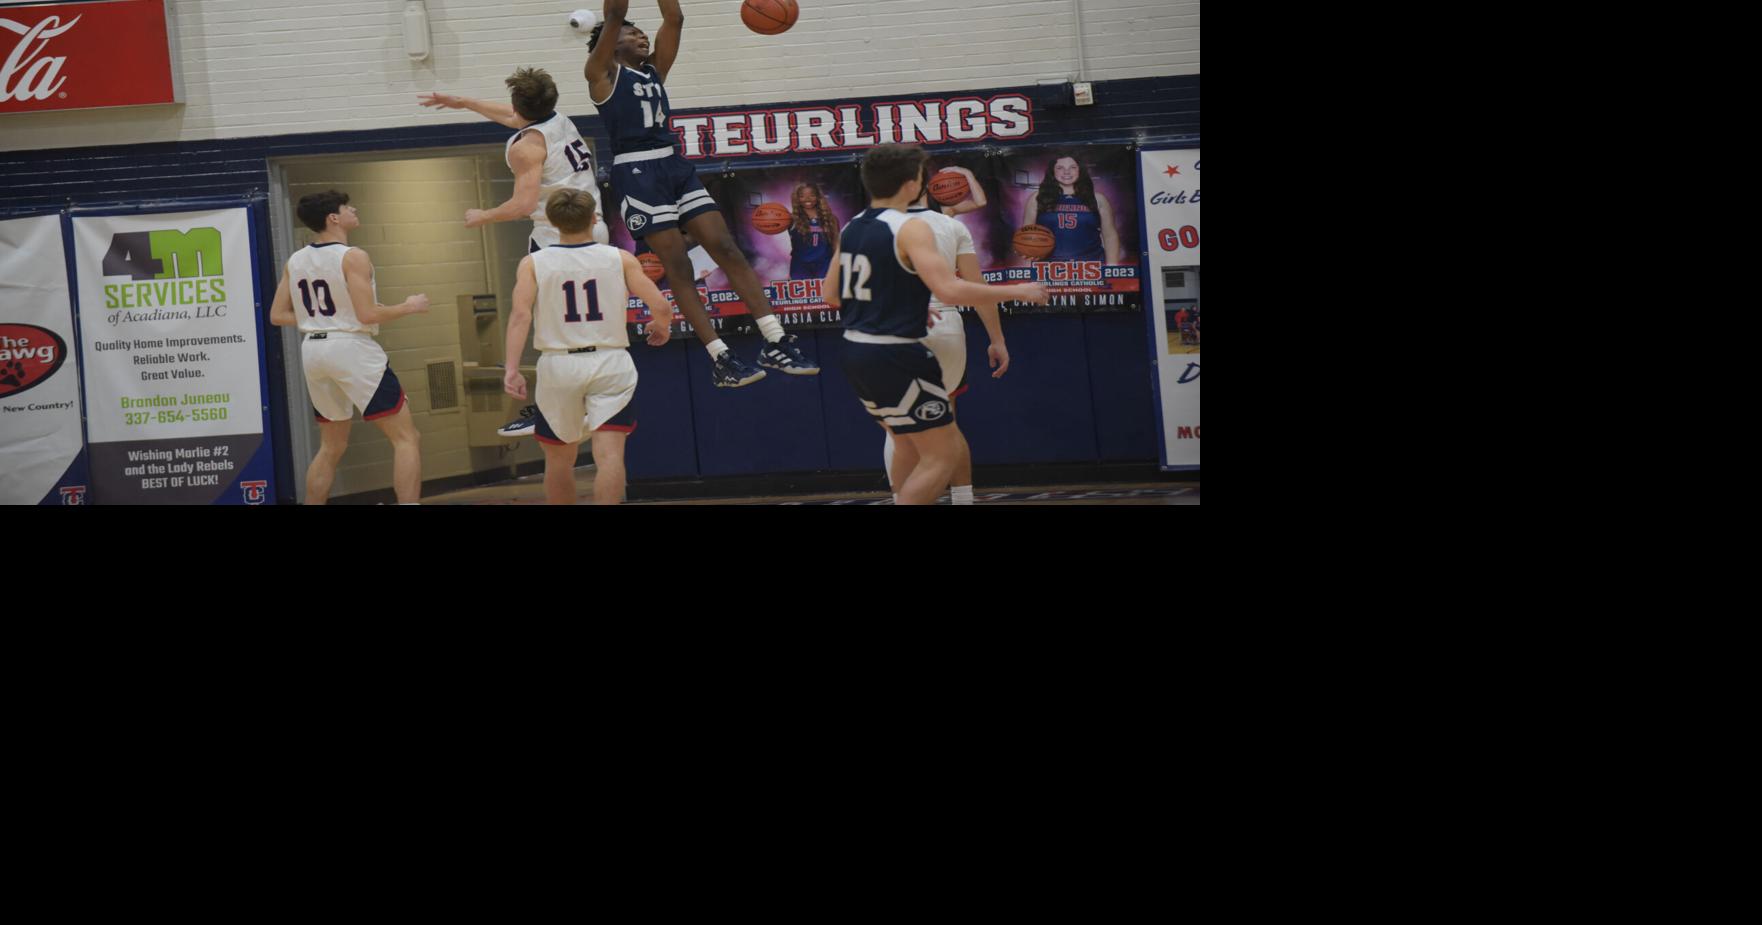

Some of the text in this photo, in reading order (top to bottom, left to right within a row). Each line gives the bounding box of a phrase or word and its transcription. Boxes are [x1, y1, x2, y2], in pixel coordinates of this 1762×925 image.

[640, 100, 666, 128] 14
[669, 93, 1034, 159] TEURLINGS
[1150, 190, 1187, 205] Girls
[1057, 213, 1078, 229] 15
[982, 271, 1003, 282] 023
[1006, 268, 1031, 279] 022
[1032, 260, 1102, 281] TCHS
[1104, 268, 1134, 278] 2023
[104, 278, 227, 309] SERVICES
[298, 278, 336, 317] 10
[770, 278, 827, 301] TCH
[562, 279, 603, 323] 11
[1084, 294, 1125, 306] SIMON
[108, 305, 228, 326] of Acadiana, LLC
[0, 335, 29, 348] he
[95, 334, 247, 352] Quality Home Improvements.
[0, 345, 55, 363] awg
[133, 351, 211, 366] Reliable Work.
[141, 368, 205, 382] Great Value.
[3, 400, 74, 413] New Country!
[120, 392, 230, 409] Brandon Juneau
[125, 407, 228, 426] 337-654-5560
[128, 445, 229, 463] Wishing Marlie #2
[125, 460, 234, 477] and the Lady Rebels
[142, 474, 219, 489] BEST OF LUCK!
